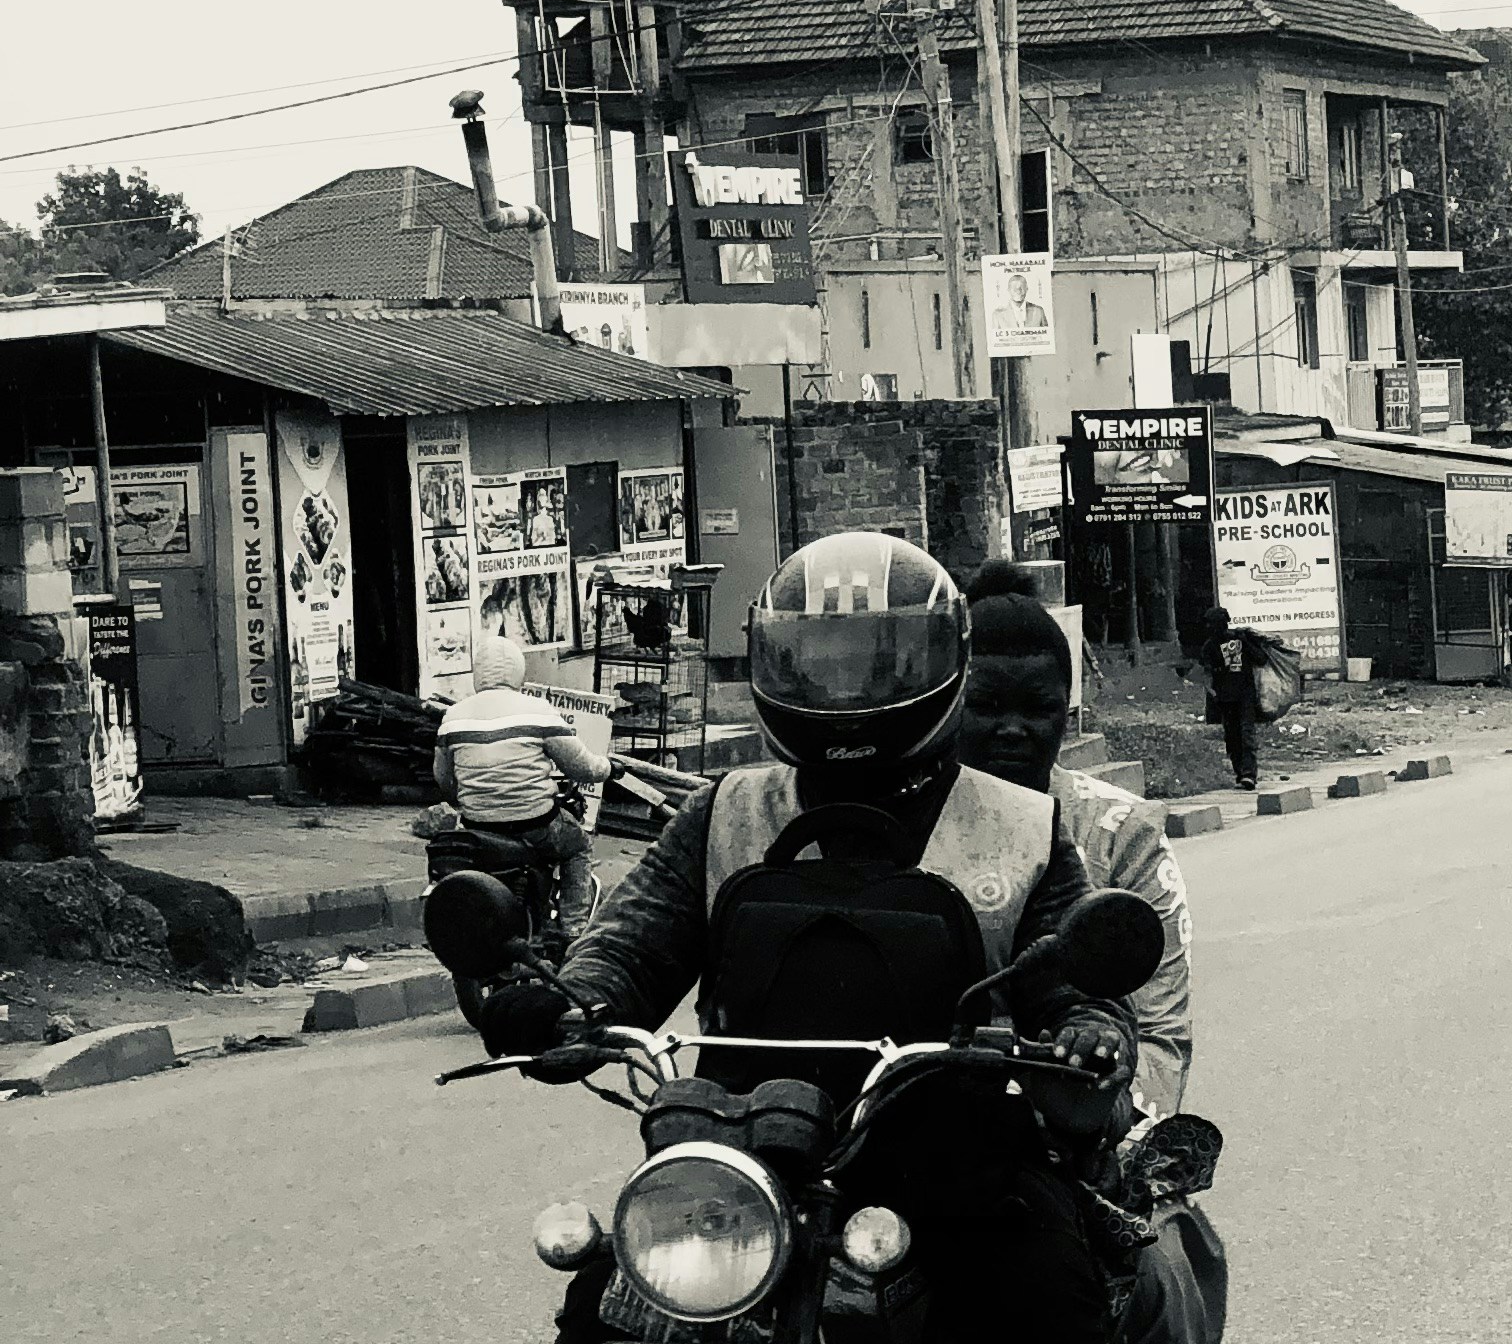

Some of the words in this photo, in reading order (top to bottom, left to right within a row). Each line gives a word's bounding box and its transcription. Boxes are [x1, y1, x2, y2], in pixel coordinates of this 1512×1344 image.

[716, 166, 803, 204] EMPIRE
[709, 218, 752, 238] DENTAL
[761, 218, 795, 238] CLINIC
[597, 291, 629, 305] BRANCH
[1102, 417, 1203, 439] EMPIRE
[417, 444, 439, 456] PORK
[440, 443, 461, 455] JOINT
[1097, 439, 1141, 450] DENTAL
[1145, 438, 1185, 449] CLINIC
[131, 470, 158, 480] PORK
[160, 469, 189, 479] JOINT
[1479, 476, 1506, 486] TRUST
[240, 451, 260, 531] JOINT
[1104, 485, 1158, 494] Transforming
[1159, 484, 1187, 492] Smiles
[1215, 494, 1269, 521] KIDS
[1270, 500, 1282, 513] AT
[1284, 491, 1331, 517] ARK
[1217, 521, 1331, 542] PRE-SCHOOL
[477, 558, 515, 574] REGINA'S
[517, 554, 541, 568] PORK
[544, 552, 568, 566] JOINT
[243, 536, 265, 610] PORK
[1259, 587, 1293, 596] Leaders
[92, 616, 115, 628] DARE
[117, 615, 129, 626] TO
[1229, 612, 1281, 625] GISTRATION
[1282, 613, 1292, 622] IN
[1293, 611, 1336, 621] PROGRESS
[546, 692, 612, 717] STATIONERY
